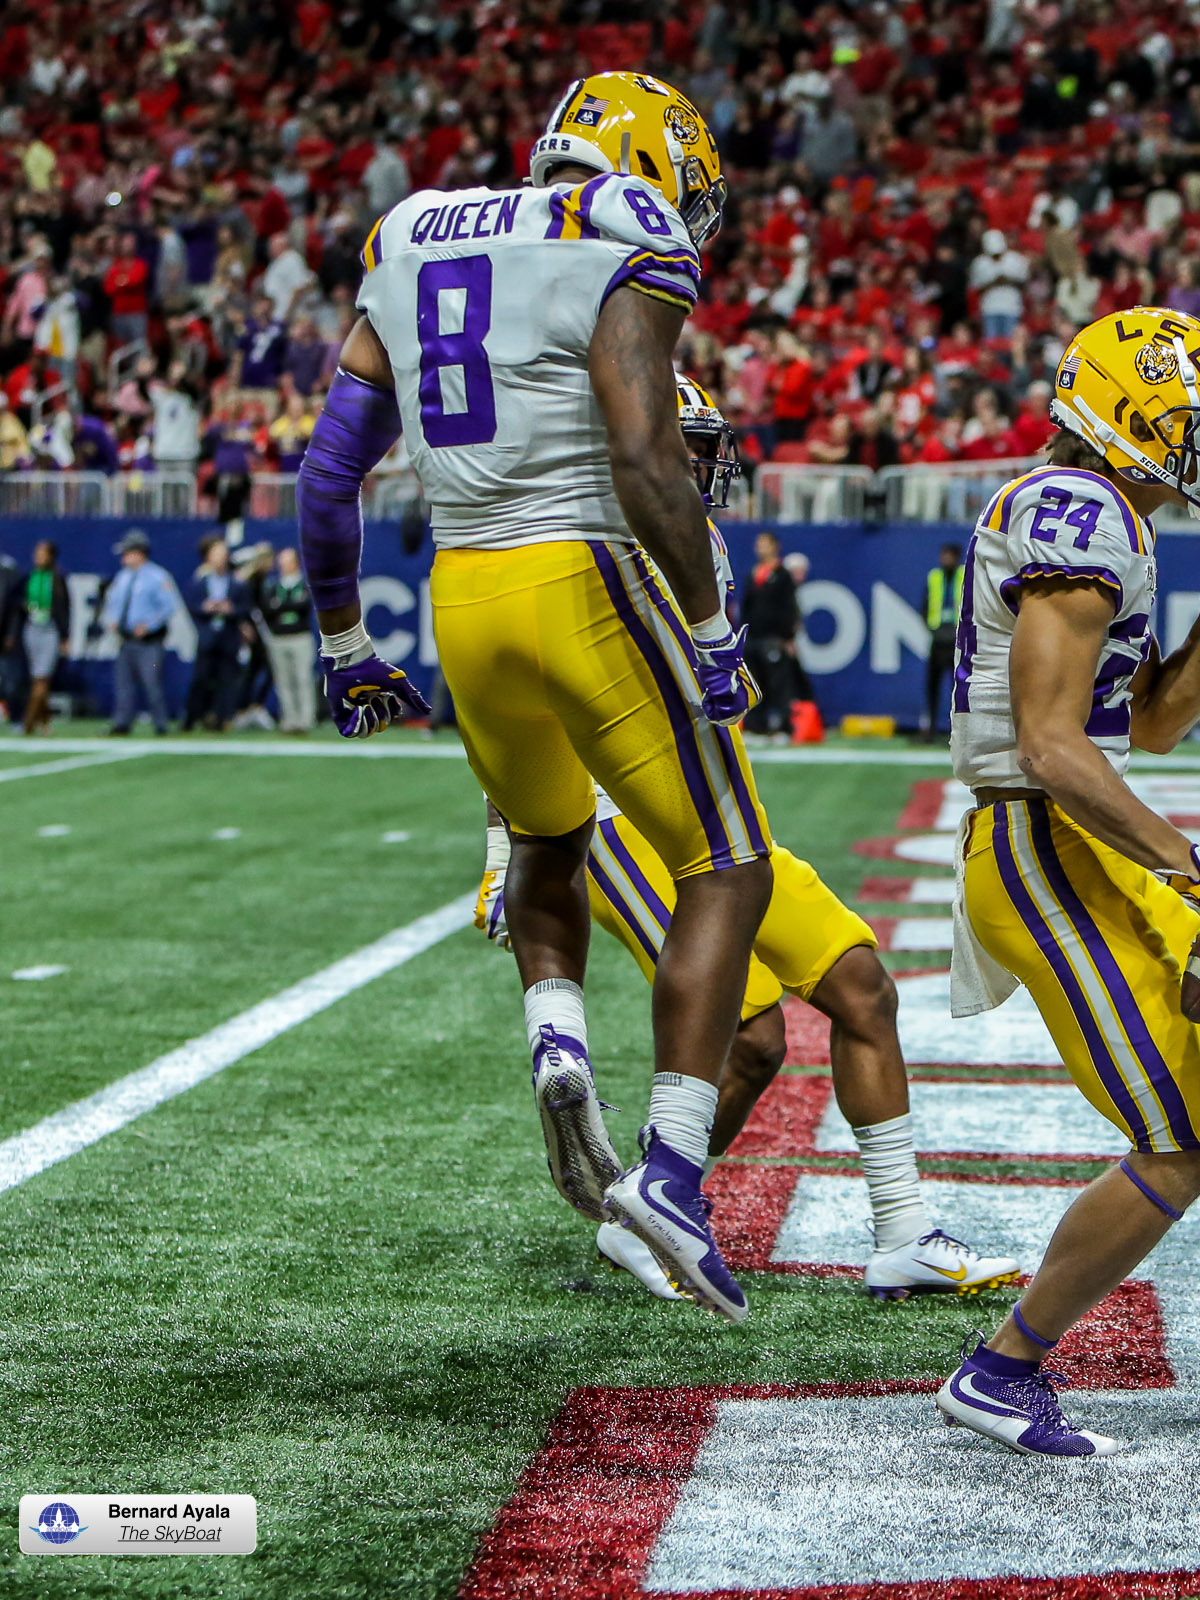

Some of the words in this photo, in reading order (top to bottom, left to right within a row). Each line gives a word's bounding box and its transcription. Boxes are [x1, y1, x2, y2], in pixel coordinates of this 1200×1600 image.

[410, 194, 522, 245] QUEEN
[623, 189, 672, 236] 8
[417, 254, 497, 448] 8
[1030, 486, 1104, 551] 24
